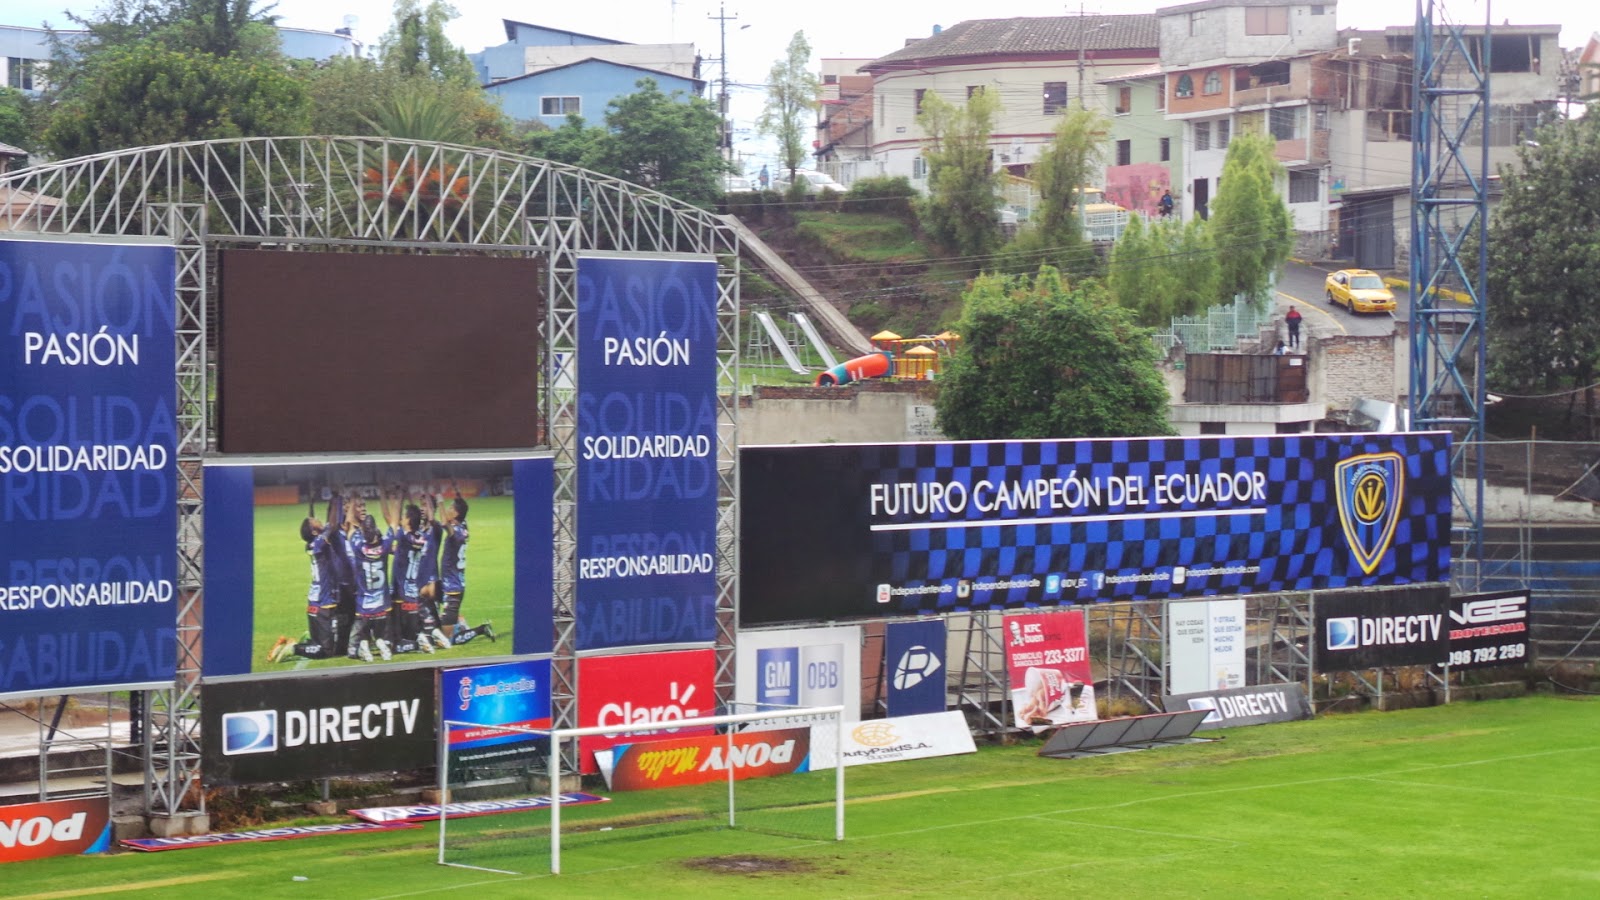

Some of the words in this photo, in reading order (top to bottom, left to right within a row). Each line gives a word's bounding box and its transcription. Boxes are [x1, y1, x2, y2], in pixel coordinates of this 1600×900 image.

[25, 325, 139, 366] PASIÓN
[604, 331, 690, 367] PASIÓN
[0, 444, 167, 474] SOLIDARIDAD
[582, 435, 710, 460] SOLIDARIDAD
[870, 480, 968, 516] FUTURO
[973, 469, 1101, 513] CAMPEÓN
[1108, 475, 1150, 506] DEL
[1155, 470, 1266, 503] ECUADOR
[362, 561, 386, 590] 15
[580, 553, 713, 579] RESPONSABILIDAD
[0, 579, 173, 611] RESPONSABILIDAD
[1361, 614, 1442, 646] DIRECTV
[1044, 646, 1085, 665] 233-3377
[1473, 646, 1497, 663] 792
[1499, 643, 1526, 660] 259
[765, 661, 791, 689] GM
[807, 661, 839, 690] OBB
[597, 701, 684, 739] Claro
[1218, 691, 1289, 719] DIRECTV
[284, 698, 420, 748] DIRECTV
[636, 746, 701, 781] Malta
[699, 739, 796, 773] PONY
